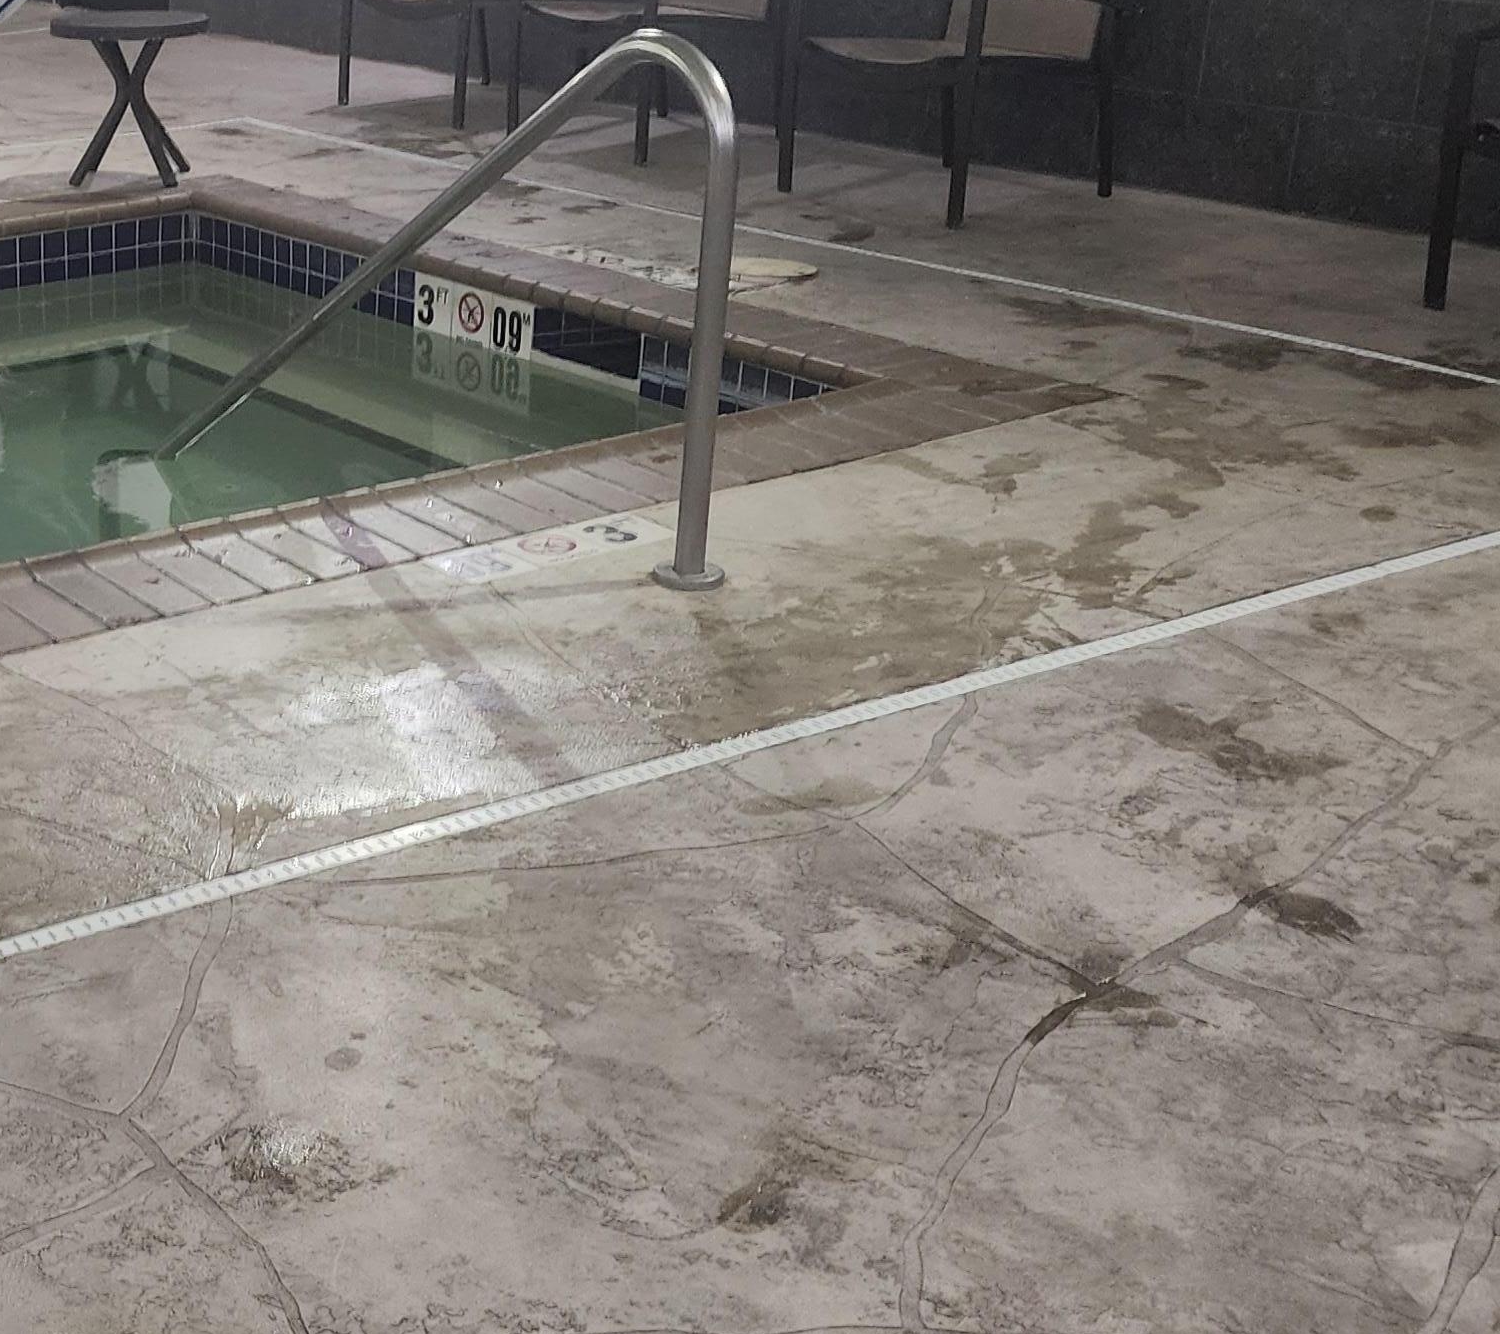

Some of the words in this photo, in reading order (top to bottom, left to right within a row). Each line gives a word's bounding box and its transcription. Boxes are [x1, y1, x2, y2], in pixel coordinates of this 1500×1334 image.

[417, 284, 435, 326] 3
[436, 286, 449, 305] FT
[522, 312, 531, 327] M
